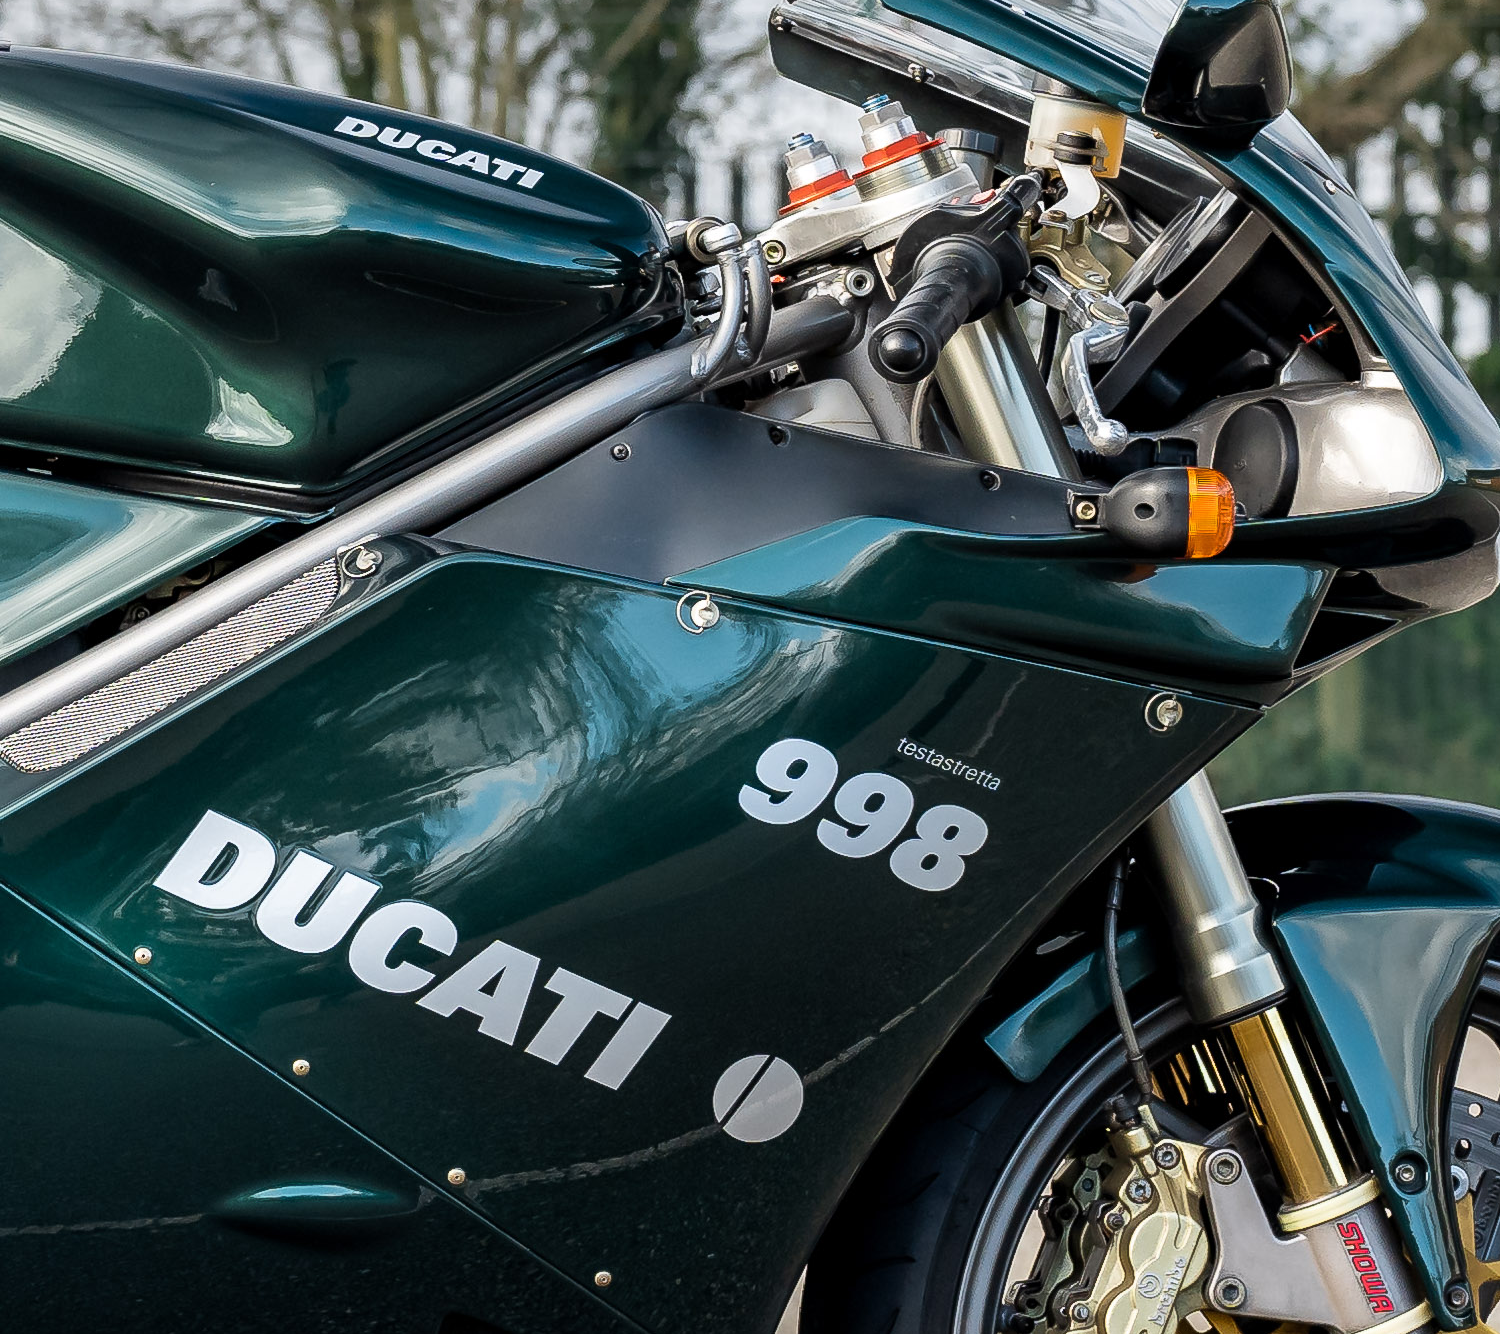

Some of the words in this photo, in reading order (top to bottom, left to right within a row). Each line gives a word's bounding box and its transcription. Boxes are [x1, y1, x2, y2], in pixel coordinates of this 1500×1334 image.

[334, 115, 545, 189] DUCATI
[896, 736, 1001, 791] testastretta
[738, 738, 989, 892] 998
[153, 808, 673, 1091] DUCATI
[1147, 1256, 1186, 1327] brembo
[1336, 1221, 1395, 1314] SHOWA
